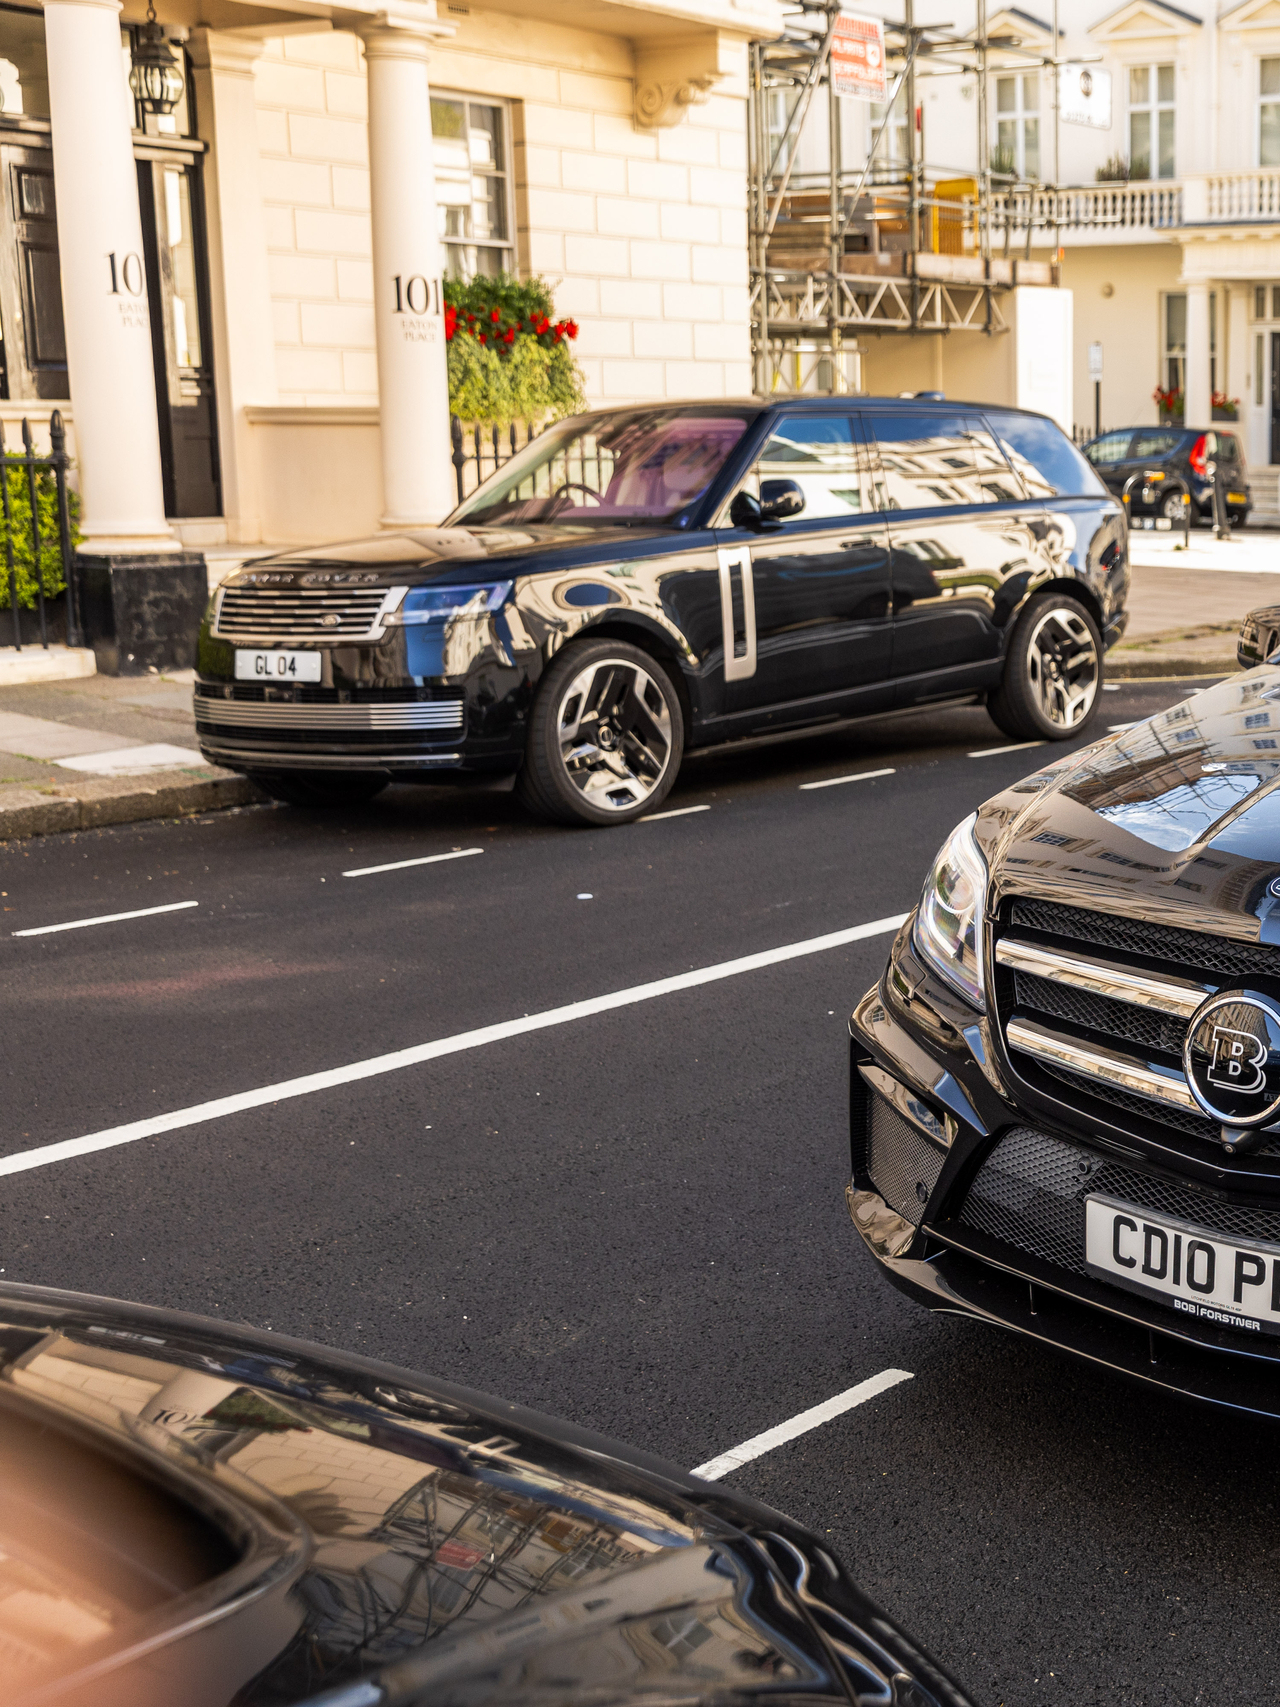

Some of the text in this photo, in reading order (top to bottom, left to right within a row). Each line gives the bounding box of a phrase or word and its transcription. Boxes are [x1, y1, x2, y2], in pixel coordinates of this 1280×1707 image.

[390, 274, 442, 316] 101
[255, 655, 273, 675] GL
[1207, 1025, 1268, 1094] B
[1113, 1214, 1216, 1295] CD10
